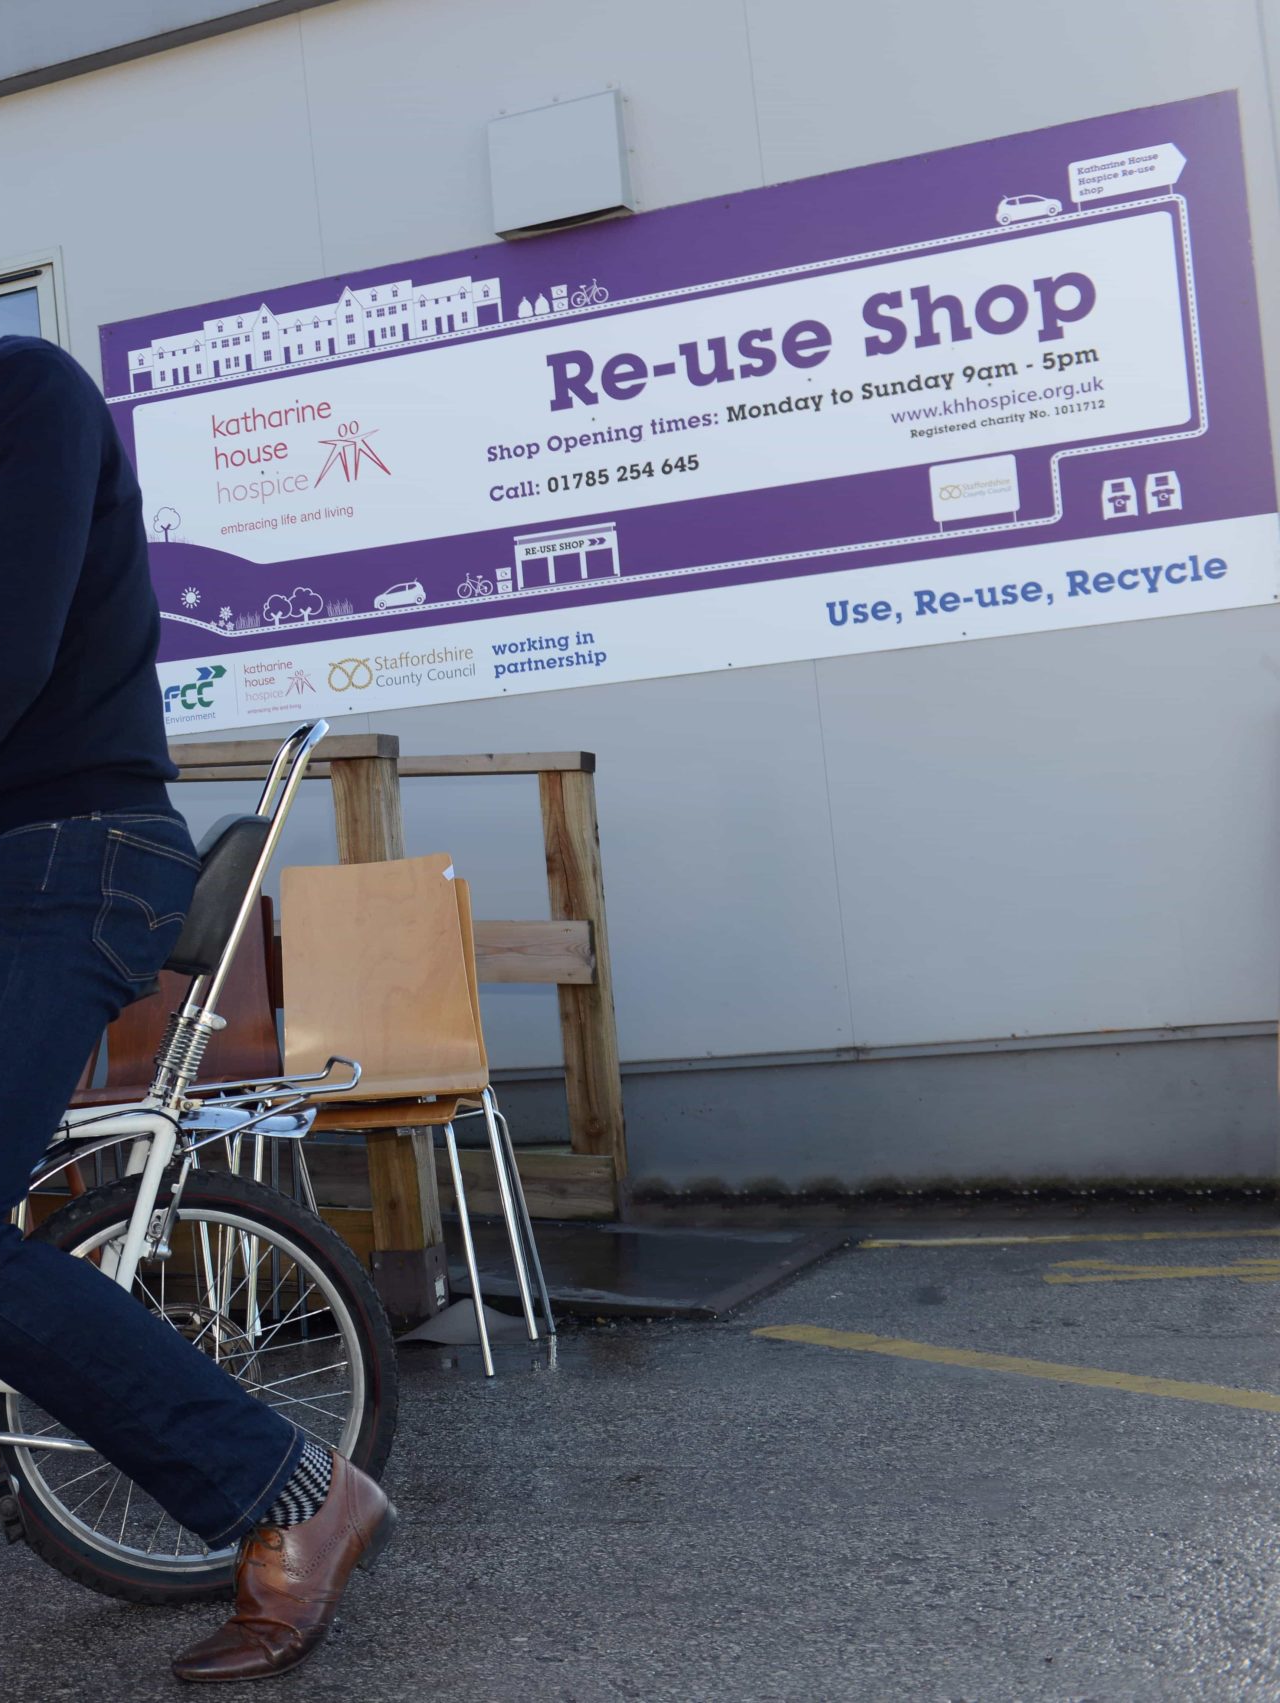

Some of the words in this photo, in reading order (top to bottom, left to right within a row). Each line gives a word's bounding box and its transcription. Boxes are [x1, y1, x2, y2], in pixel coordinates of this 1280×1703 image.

[1077, 159, 1126, 175] Katharine
[1128, 153, 1158, 165] House
[1078, 172, 1119, 186] Hospice
[1122, 165, 1155, 177] Re-use
[1079, 186, 1104, 196] shop
[546, 319, 833, 412] Re-use
[862, 271, 1097, 357] Shop
[487, 440, 541, 462] Shop
[547, 423, 644, 453] Opening
[650, 412, 719, 435] times:
[726, 394, 824, 423] Monday
[831, 386, 854, 406] to
[861, 371, 955, 401] Sunday
[962, 360, 1019, 384] 9am
[1042, 347, 1100, 372] 5pm
[891, 375, 1105, 425] www.khhospice.org.uk
[211, 400, 333, 439] katharine
[910, 419, 977, 439] Registered
[980, 411, 1026, 429] charity
[1029, 408, 1050, 422] No.
[1054, 399, 1106, 417] 1011712
[214, 441, 289, 470] house
[217, 470, 310, 505] hospice
[489, 480, 541, 502] Call:
[547, 469, 610, 493] 01785
[616, 461, 655, 483] 254
[661, 454, 700, 475] 645
[220, 517, 279, 536] embracing
[281, 511, 297, 526] life
[300, 508, 322, 523] and
[324, 504, 355, 521] living
[524, 544, 557, 556] RE-USE
[559, 539, 585, 551] SHOP
[826, 598, 904, 626] Use,
[914, 580, 1054, 617] Re-use,
[1066, 555, 1229, 598] Recycle
[491, 635, 569, 655] working
[575, 630, 596, 646] in
[243, 659, 293, 675] katharine
[374, 646, 475, 671] Staffordshire
[494, 648, 608, 679] partnership
[244, 676, 276, 688] house
[375, 671, 423, 689] County
[426, 664, 476, 682] Council
[164, 680, 215, 713] FCC
[245, 687, 285, 702] hospice
[165, 711, 217, 725] Environment
